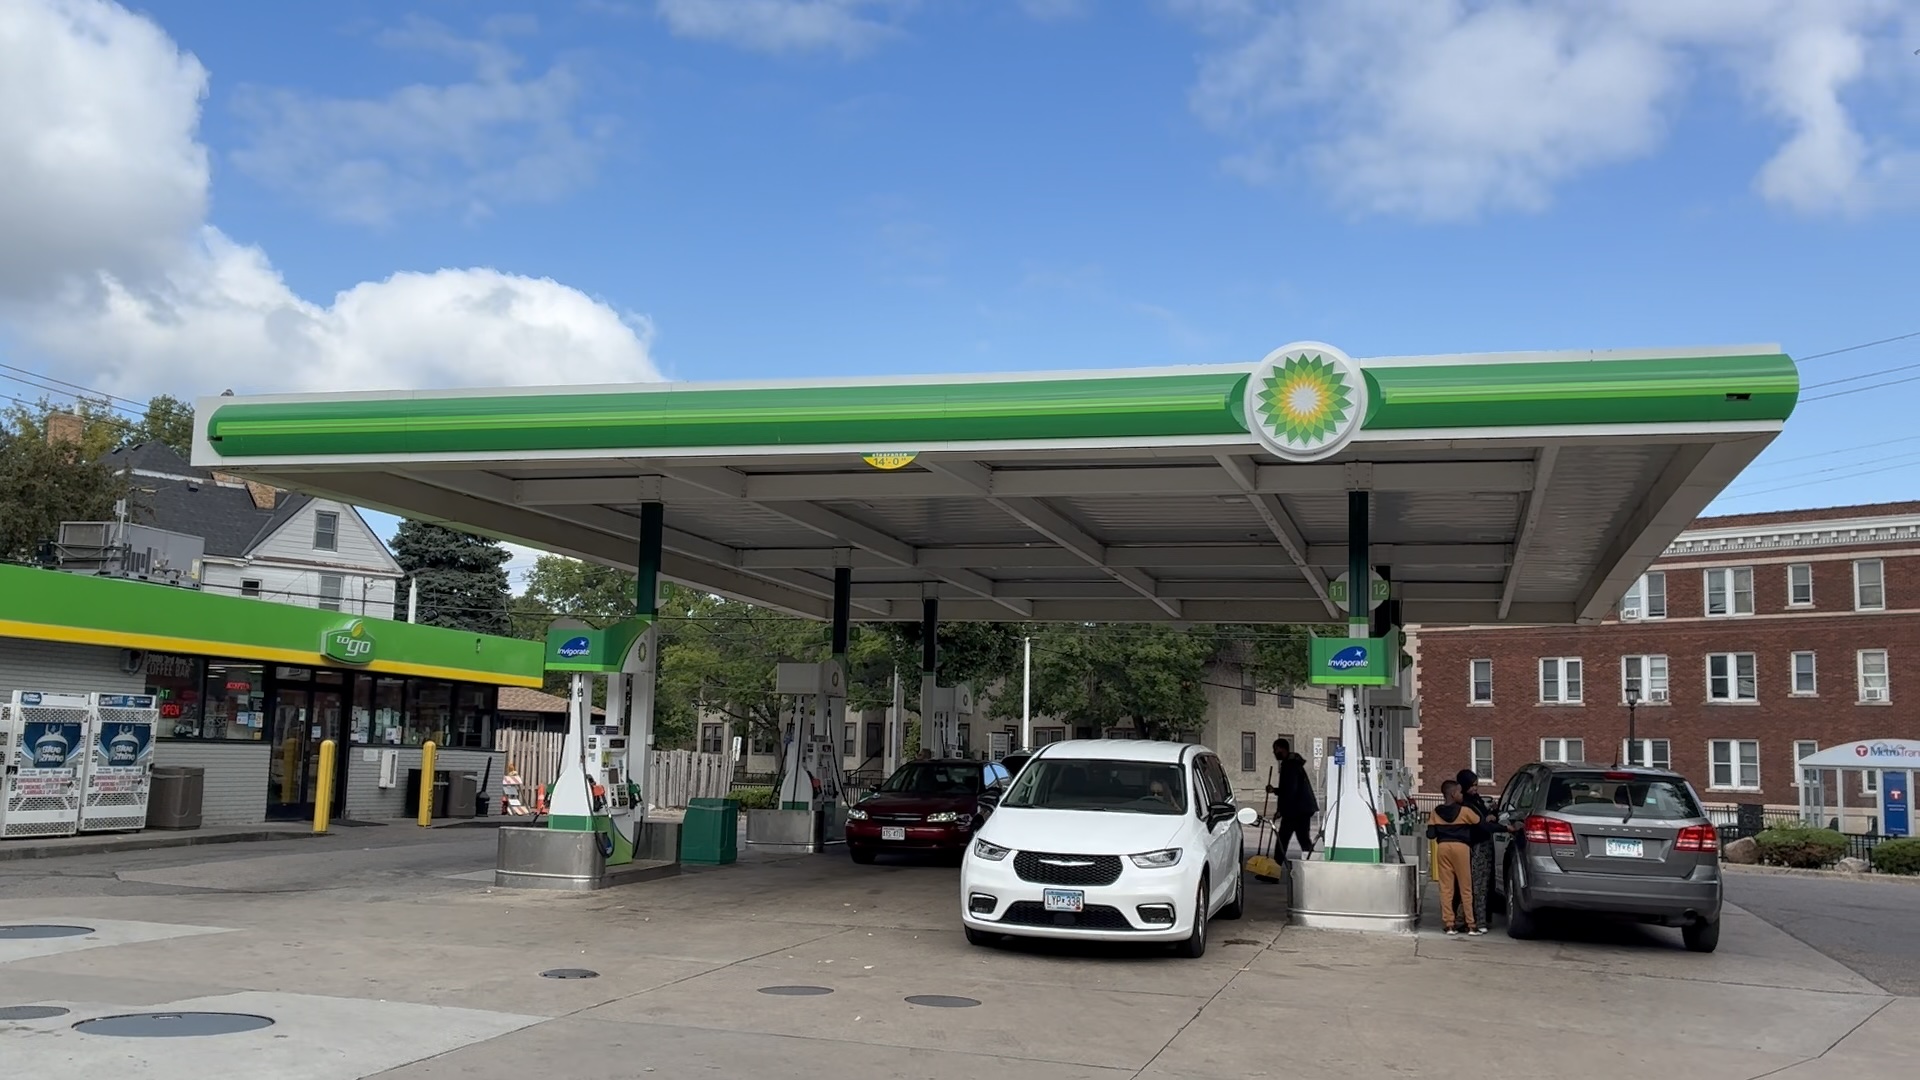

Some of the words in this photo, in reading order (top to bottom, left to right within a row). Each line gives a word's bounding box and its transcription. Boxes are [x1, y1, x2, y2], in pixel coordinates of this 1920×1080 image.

[628, 583, 635, 595] 5
[662, 583, 670, 596] 6
[1331, 585, 1343, 597] 11
[1373, 583, 1388, 596] 12
[336, 635, 350, 645] to
[345, 639, 371, 657] go
[556, 647, 591, 657] Invigorate
[1327, 658, 1369, 669] Invigorate
[161, 703, 180, 716] OPEN
[1869, 746, 1920, 758] MetroTran
[1046, 895, 1062, 906] LYP
[1066, 896, 1081, 907] 338
